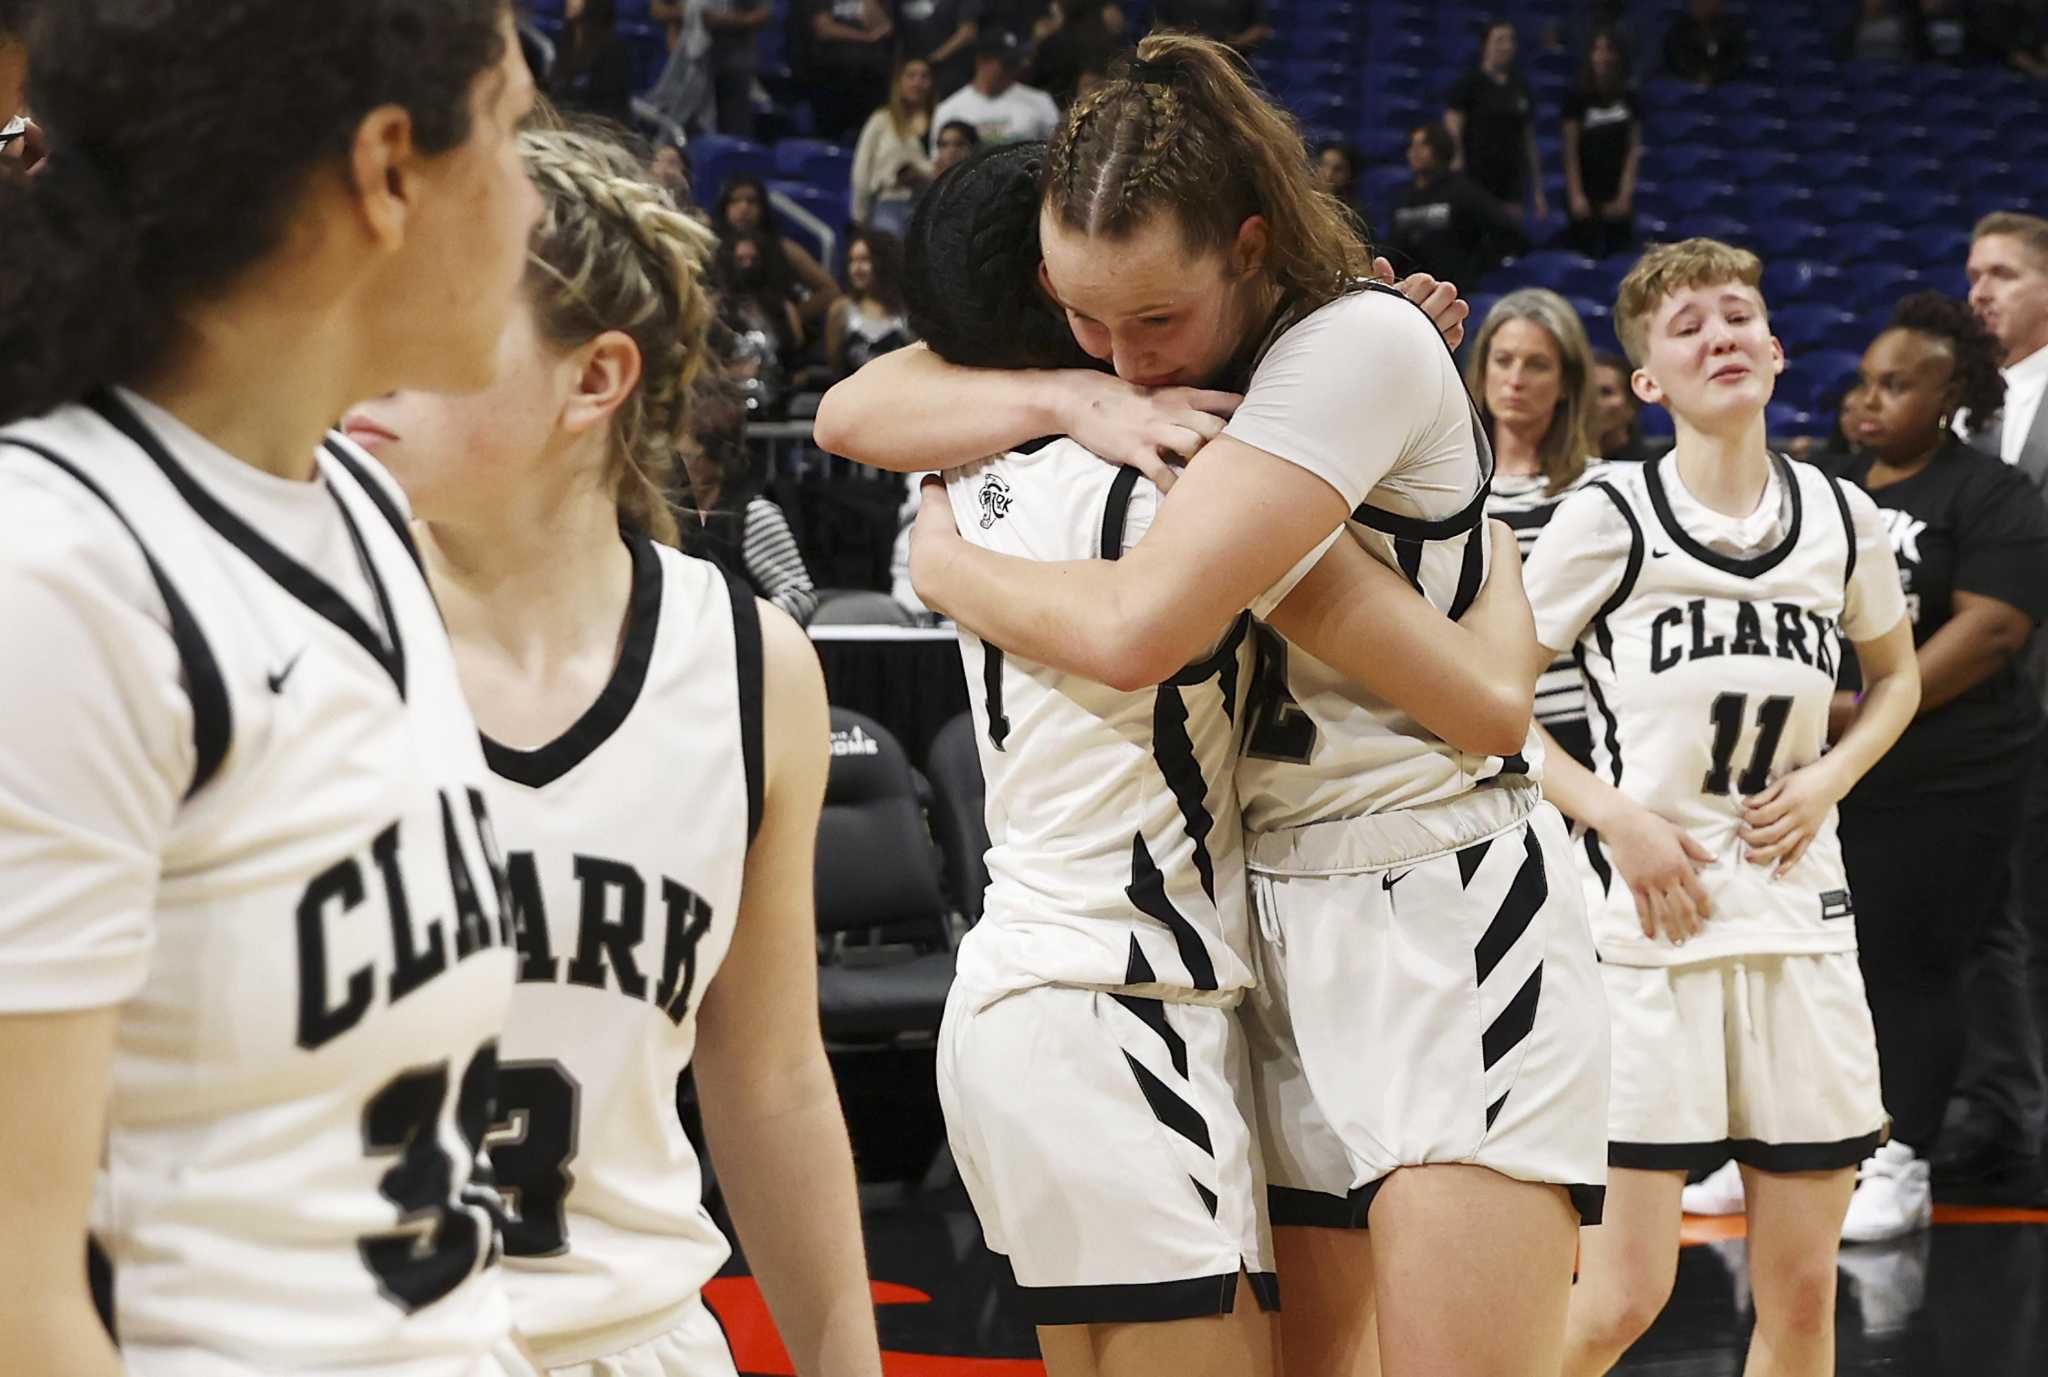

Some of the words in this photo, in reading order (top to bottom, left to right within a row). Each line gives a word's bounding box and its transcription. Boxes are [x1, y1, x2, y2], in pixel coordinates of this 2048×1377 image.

[1650, 599, 1835, 682] CLARK
[1702, 691, 1795, 797] 11
[296, 785, 515, 1051] CLA
[507, 851, 713, 1027] ARK
